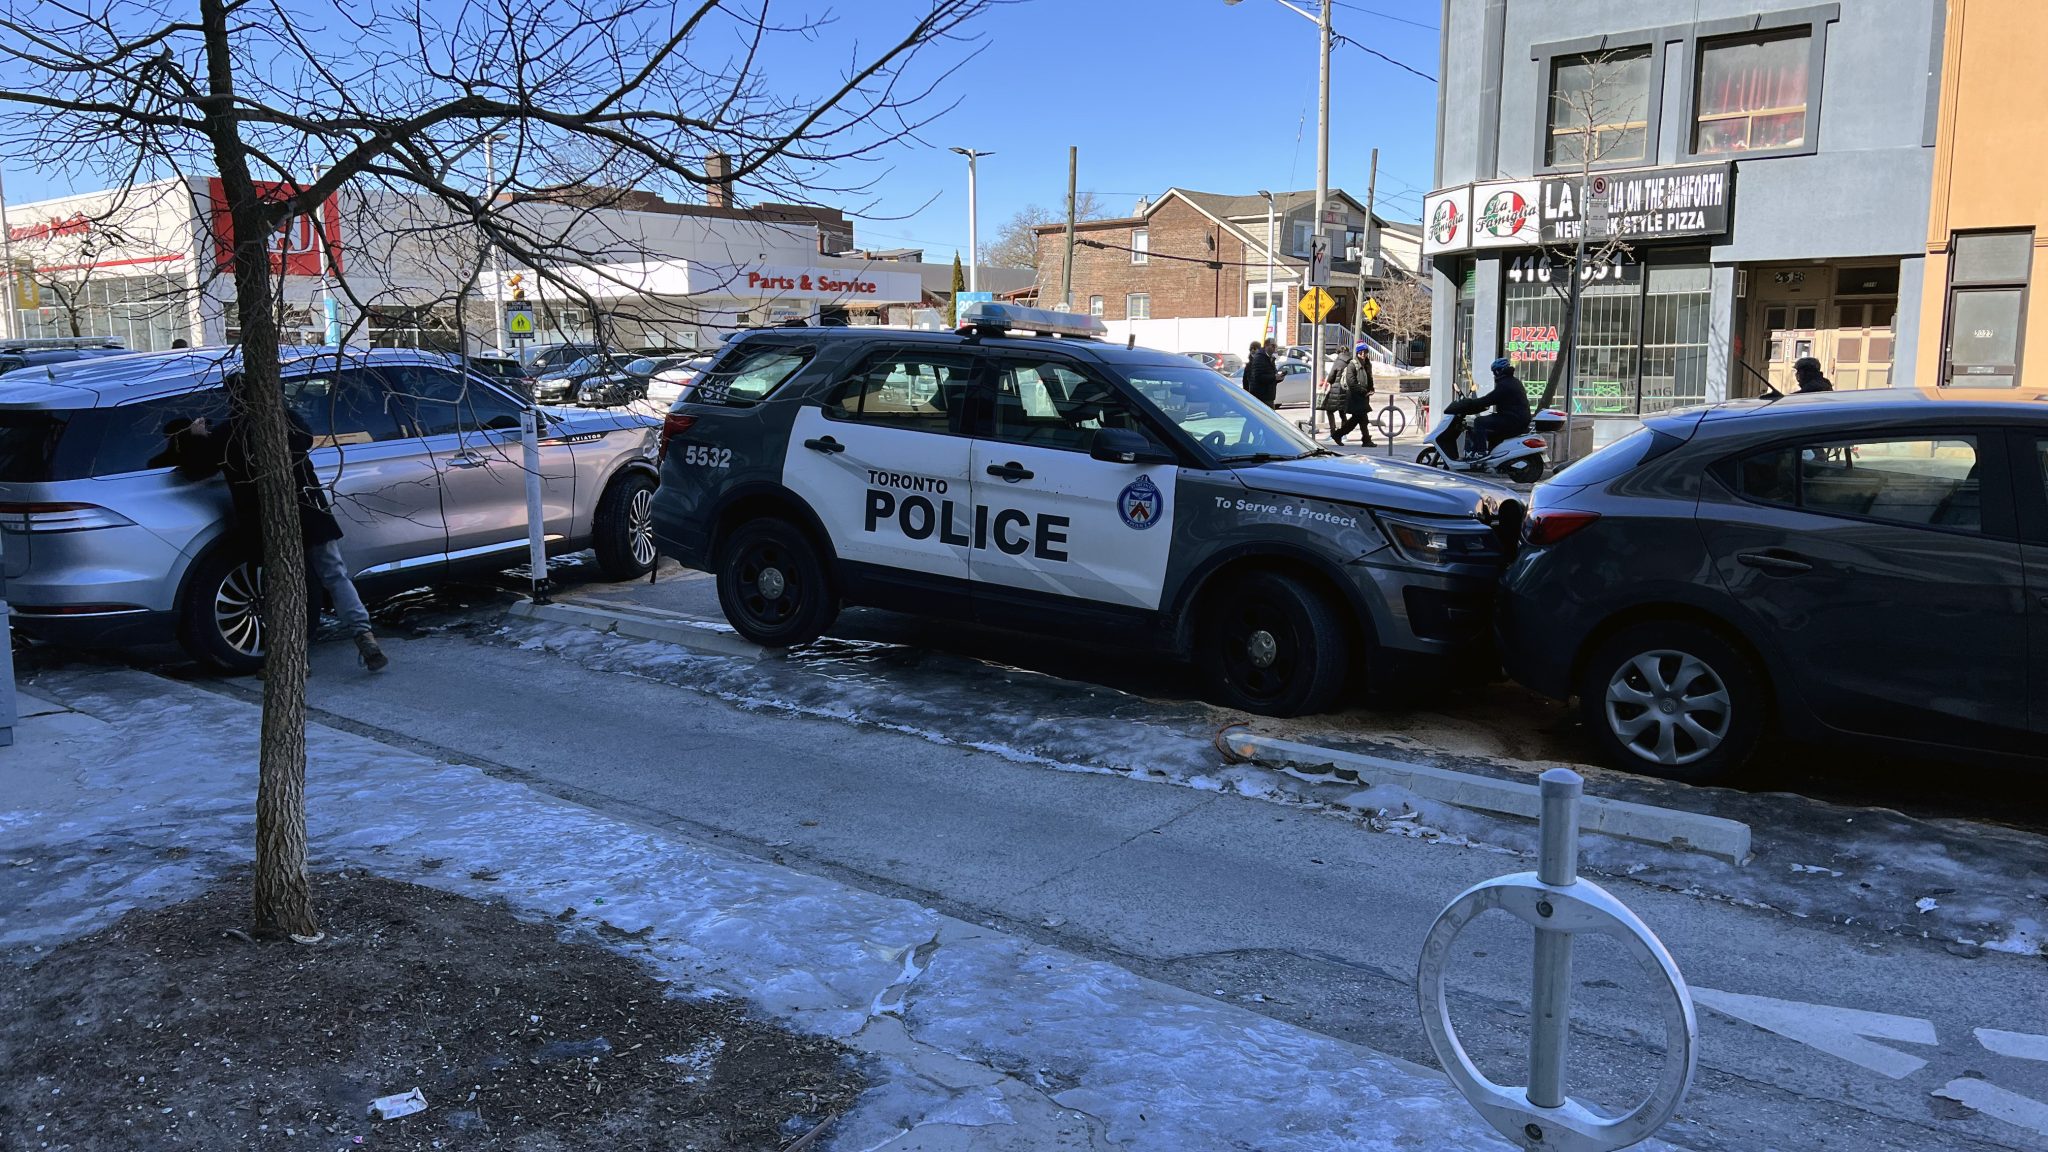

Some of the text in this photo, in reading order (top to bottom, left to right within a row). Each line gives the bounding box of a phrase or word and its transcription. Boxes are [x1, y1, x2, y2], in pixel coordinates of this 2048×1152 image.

[1489, 199, 1508, 215] La
[1544, 182, 1574, 219] LA
[1627, 179, 1643, 212] ON
[1645, 177, 1666, 210] THE
[1667, 173, 1724, 208] DANFORTH
[1428, 212, 1464, 241] Famiglia
[1475, 204, 1537, 233] Famiglia
[1623, 214, 1663, 234] STYLE
[1667, 210, 1705, 231] PIZZA
[748, 271, 877, 294] Parts & Service
[1510, 326, 1559, 341] PIZZA
[1509, 341, 1560, 352] BY THE
[1511, 351, 1558, 361] SLICE
[571, 433, 602, 442] AVIATOR
[685, 445, 732, 469] 5532
[867, 469, 949, 495] TORONTO
[1215, 496, 1357, 528] To Serve & Protect
[864, 488, 1071, 563] POLICE
